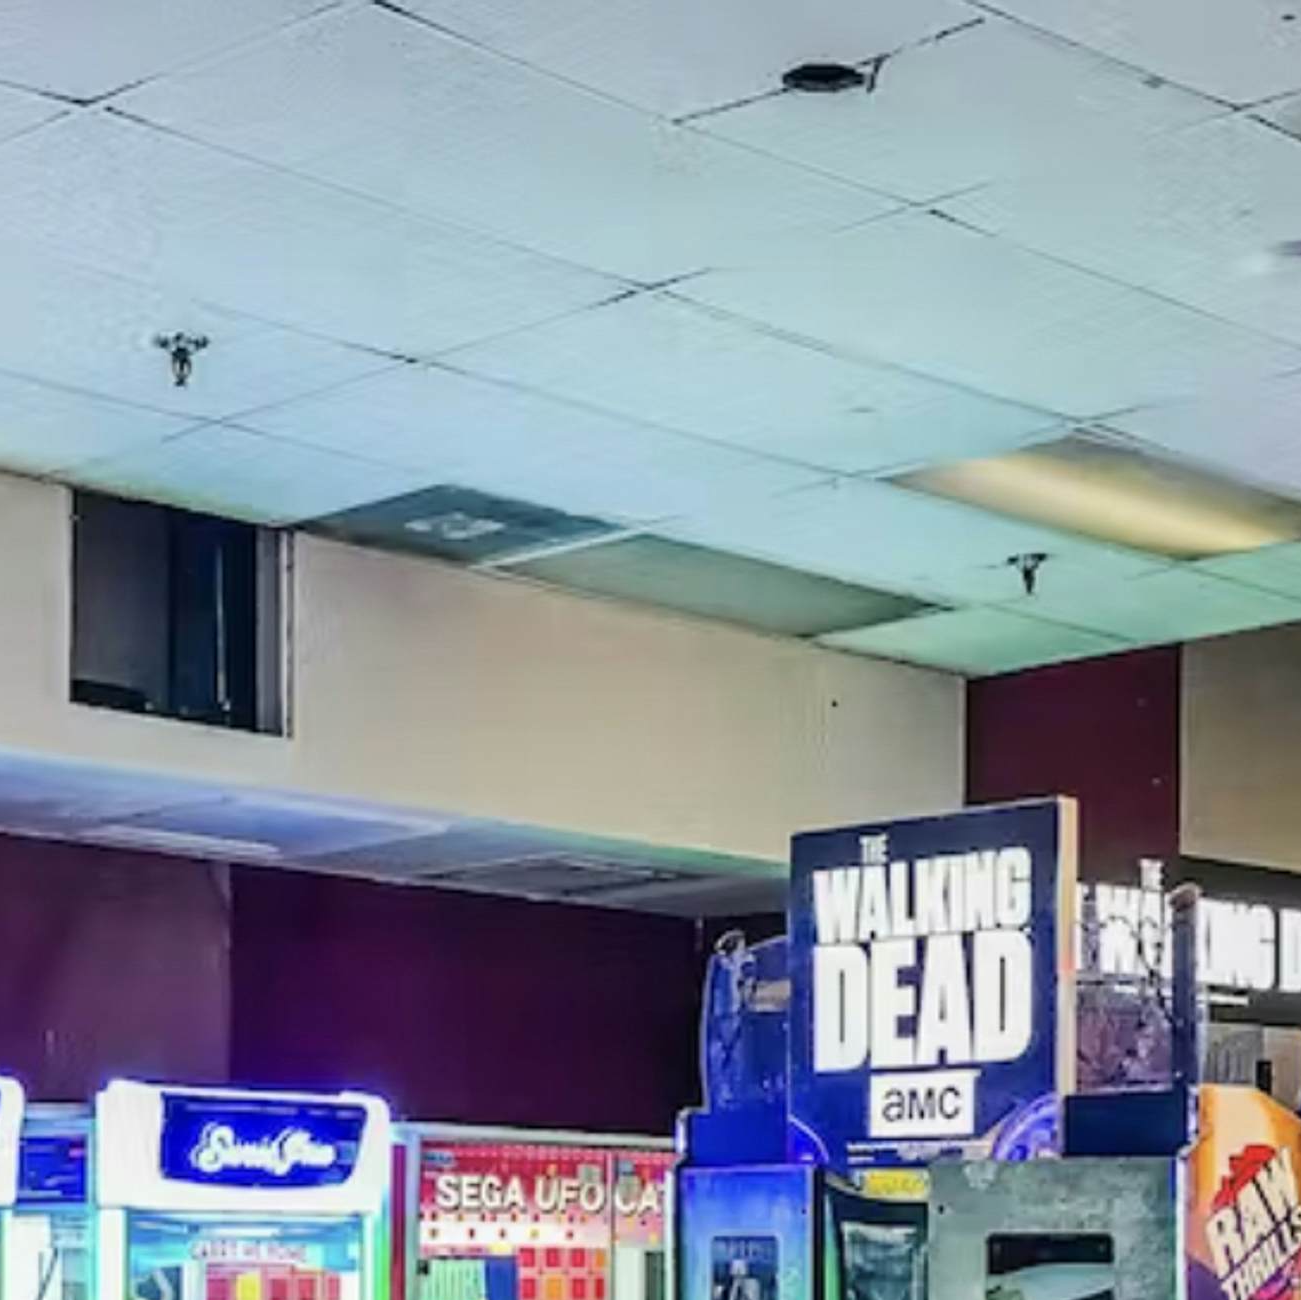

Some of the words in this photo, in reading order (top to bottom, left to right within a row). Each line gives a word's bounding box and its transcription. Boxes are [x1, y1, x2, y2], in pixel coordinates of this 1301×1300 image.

[813, 846, 1032, 944] WALKING
[813, 929, 1033, 1073] DEAD
[435, 1174, 526, 1210] SEGA
[534, 1175, 605, 1212] UFO
[614, 1182, 663, 1213] CA
[1206, 1147, 1300, 1281] RAW
